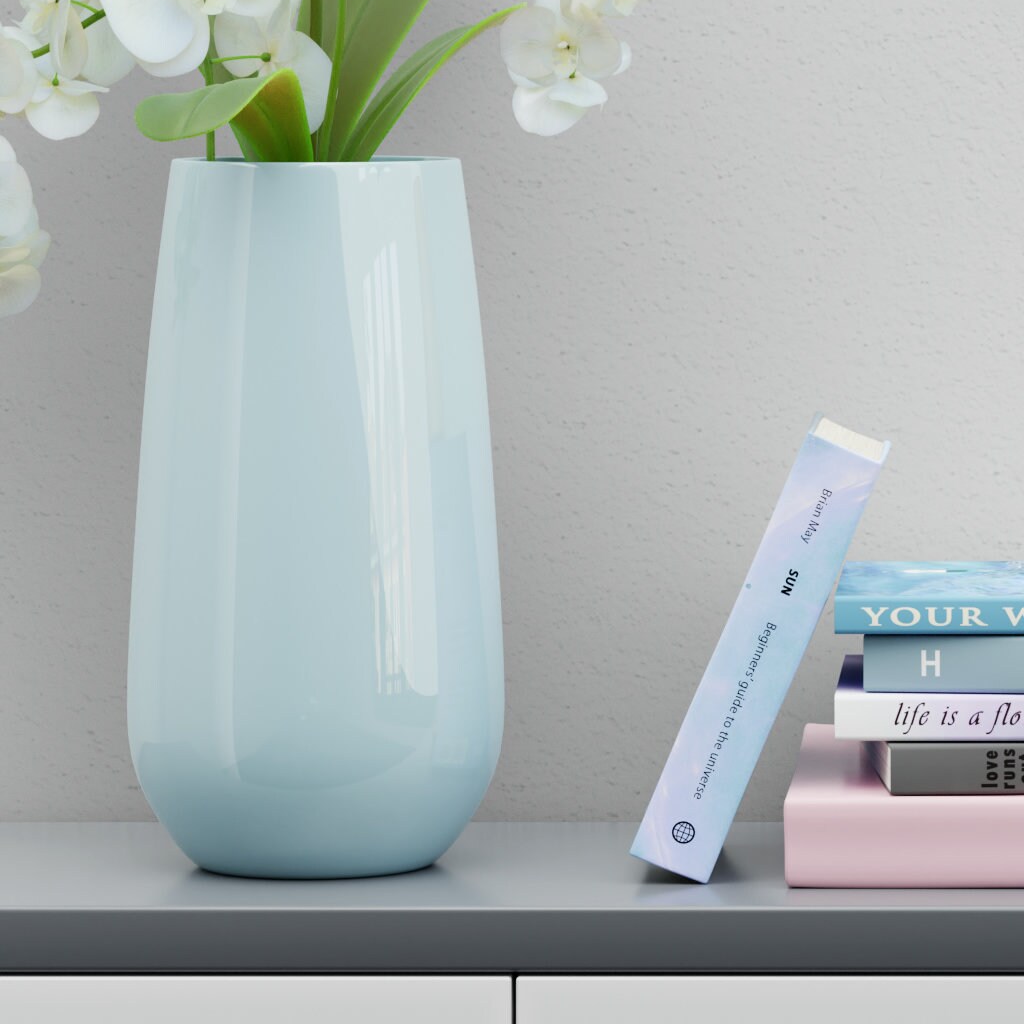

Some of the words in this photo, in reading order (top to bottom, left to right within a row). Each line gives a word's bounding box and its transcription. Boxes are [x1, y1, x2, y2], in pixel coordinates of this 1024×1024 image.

[812, 488, 833, 518] Brian
[800, 520, 820, 544] May
[780, 569, 799, 596] SUN
[860, 606, 988, 627] YOUR
[729, 680, 749, 714] guide
[723, 716, 735, 728] to
[893, 702, 929, 735] life
[941, 706, 958, 726] is
[968, 711, 984, 726] a
[714, 731, 729, 750] the
[694, 753, 719, 800] universe
[981, 750, 999, 788] love
[1003, 748, 1016, 790] runs
